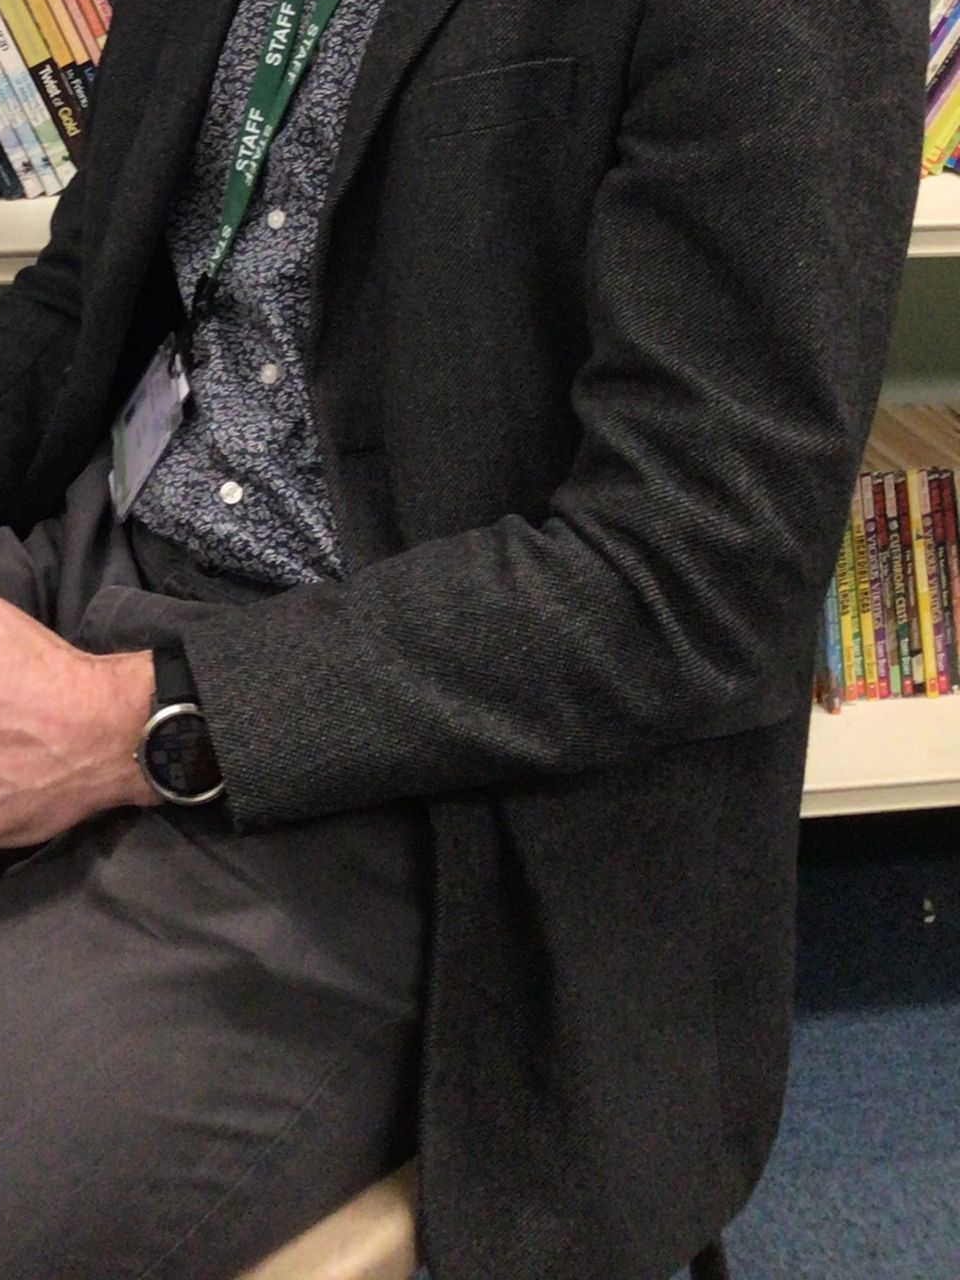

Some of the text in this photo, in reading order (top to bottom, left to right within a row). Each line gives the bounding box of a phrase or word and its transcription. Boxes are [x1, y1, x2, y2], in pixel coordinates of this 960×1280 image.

[265, 2, 297, 66] STAFF
[288, 24, 319, 86] STAFF
[38, 64, 60, 98] Twist
[58, 107, 81, 137] Gold
[236, 107, 264, 171] STAFF
[896, 597, 908, 625] CELTS
